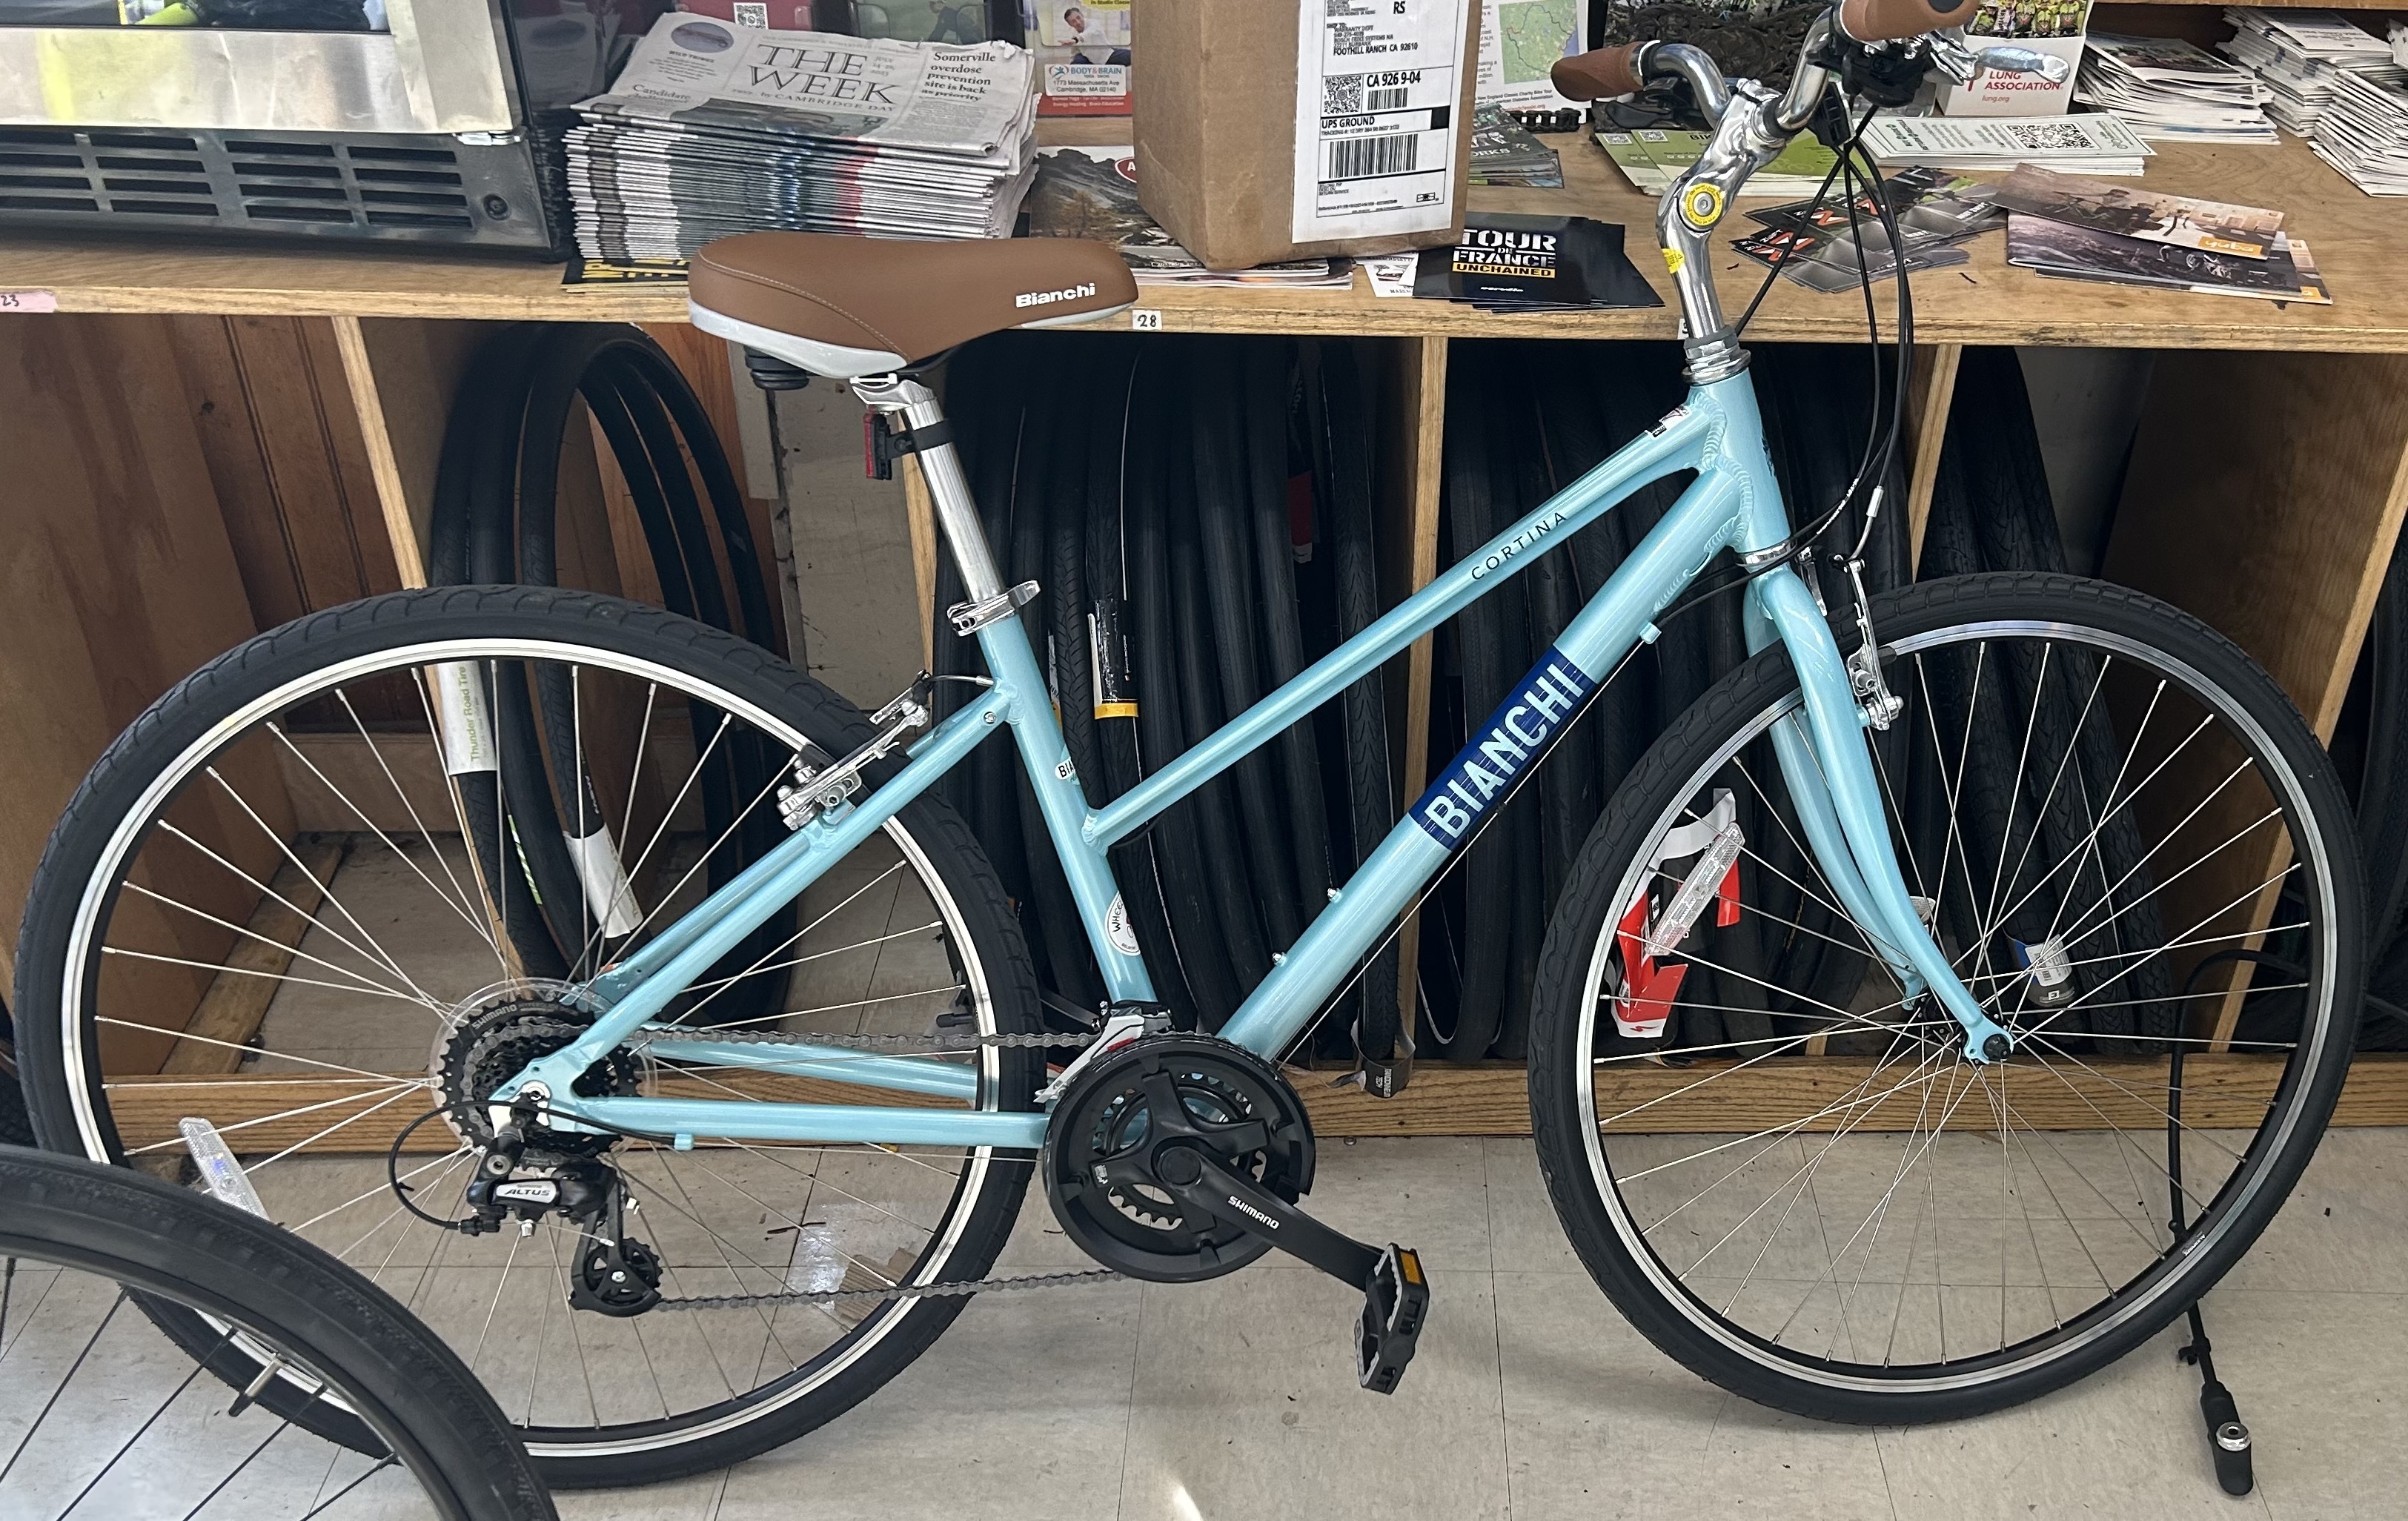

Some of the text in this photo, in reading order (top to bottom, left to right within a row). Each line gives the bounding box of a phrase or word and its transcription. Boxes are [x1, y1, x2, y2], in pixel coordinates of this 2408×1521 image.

[1393, 1, 1405, 14] RS
[1333, 42, 1418, 56] FOOTHILL RANCH CA 92610
[758, 44, 867, 76] THE
[934, 52, 995, 62] Somerville
[930, 64, 981, 73] overdose
[1989, 71, 2021, 79] LUNG
[749, 65, 901, 105] WEEK
[926, 73, 991, 85] prevention
[1367, 70, 1421, 87] CA 926 9-04
[634, 84, 691, 99] Candidate
[924, 81, 986, 94] site is back
[1985, 82, 2060, 90] ASSOCIATION
[775, 93, 863, 109] CAMBRIDGE
[935, 91, 981, 102] priority
[1982, 95, 2010, 103] lung.org
[1321, 116, 1375, 129] UPS GROUND
[1462, 228, 1556, 251] TOUR
[2205, 239, 2254, 253] yuba
[1453, 251, 1556, 268] FRANCE
[1456, 263, 1551, 276] UNCHAINED
[1015, 282, 1095, 308] Bianchi
[1137, 314, 1157, 328] 28
[1470, 511, 1568, 582] CORTINA
[458, 666, 468, 686] Tire
[463, 689, 473, 716] Road
[467, 718, 480, 762] Thunder
[1424, 662, 1585, 840] BIANCHI
[1227, 1196, 1280, 1230] SHIMANO
